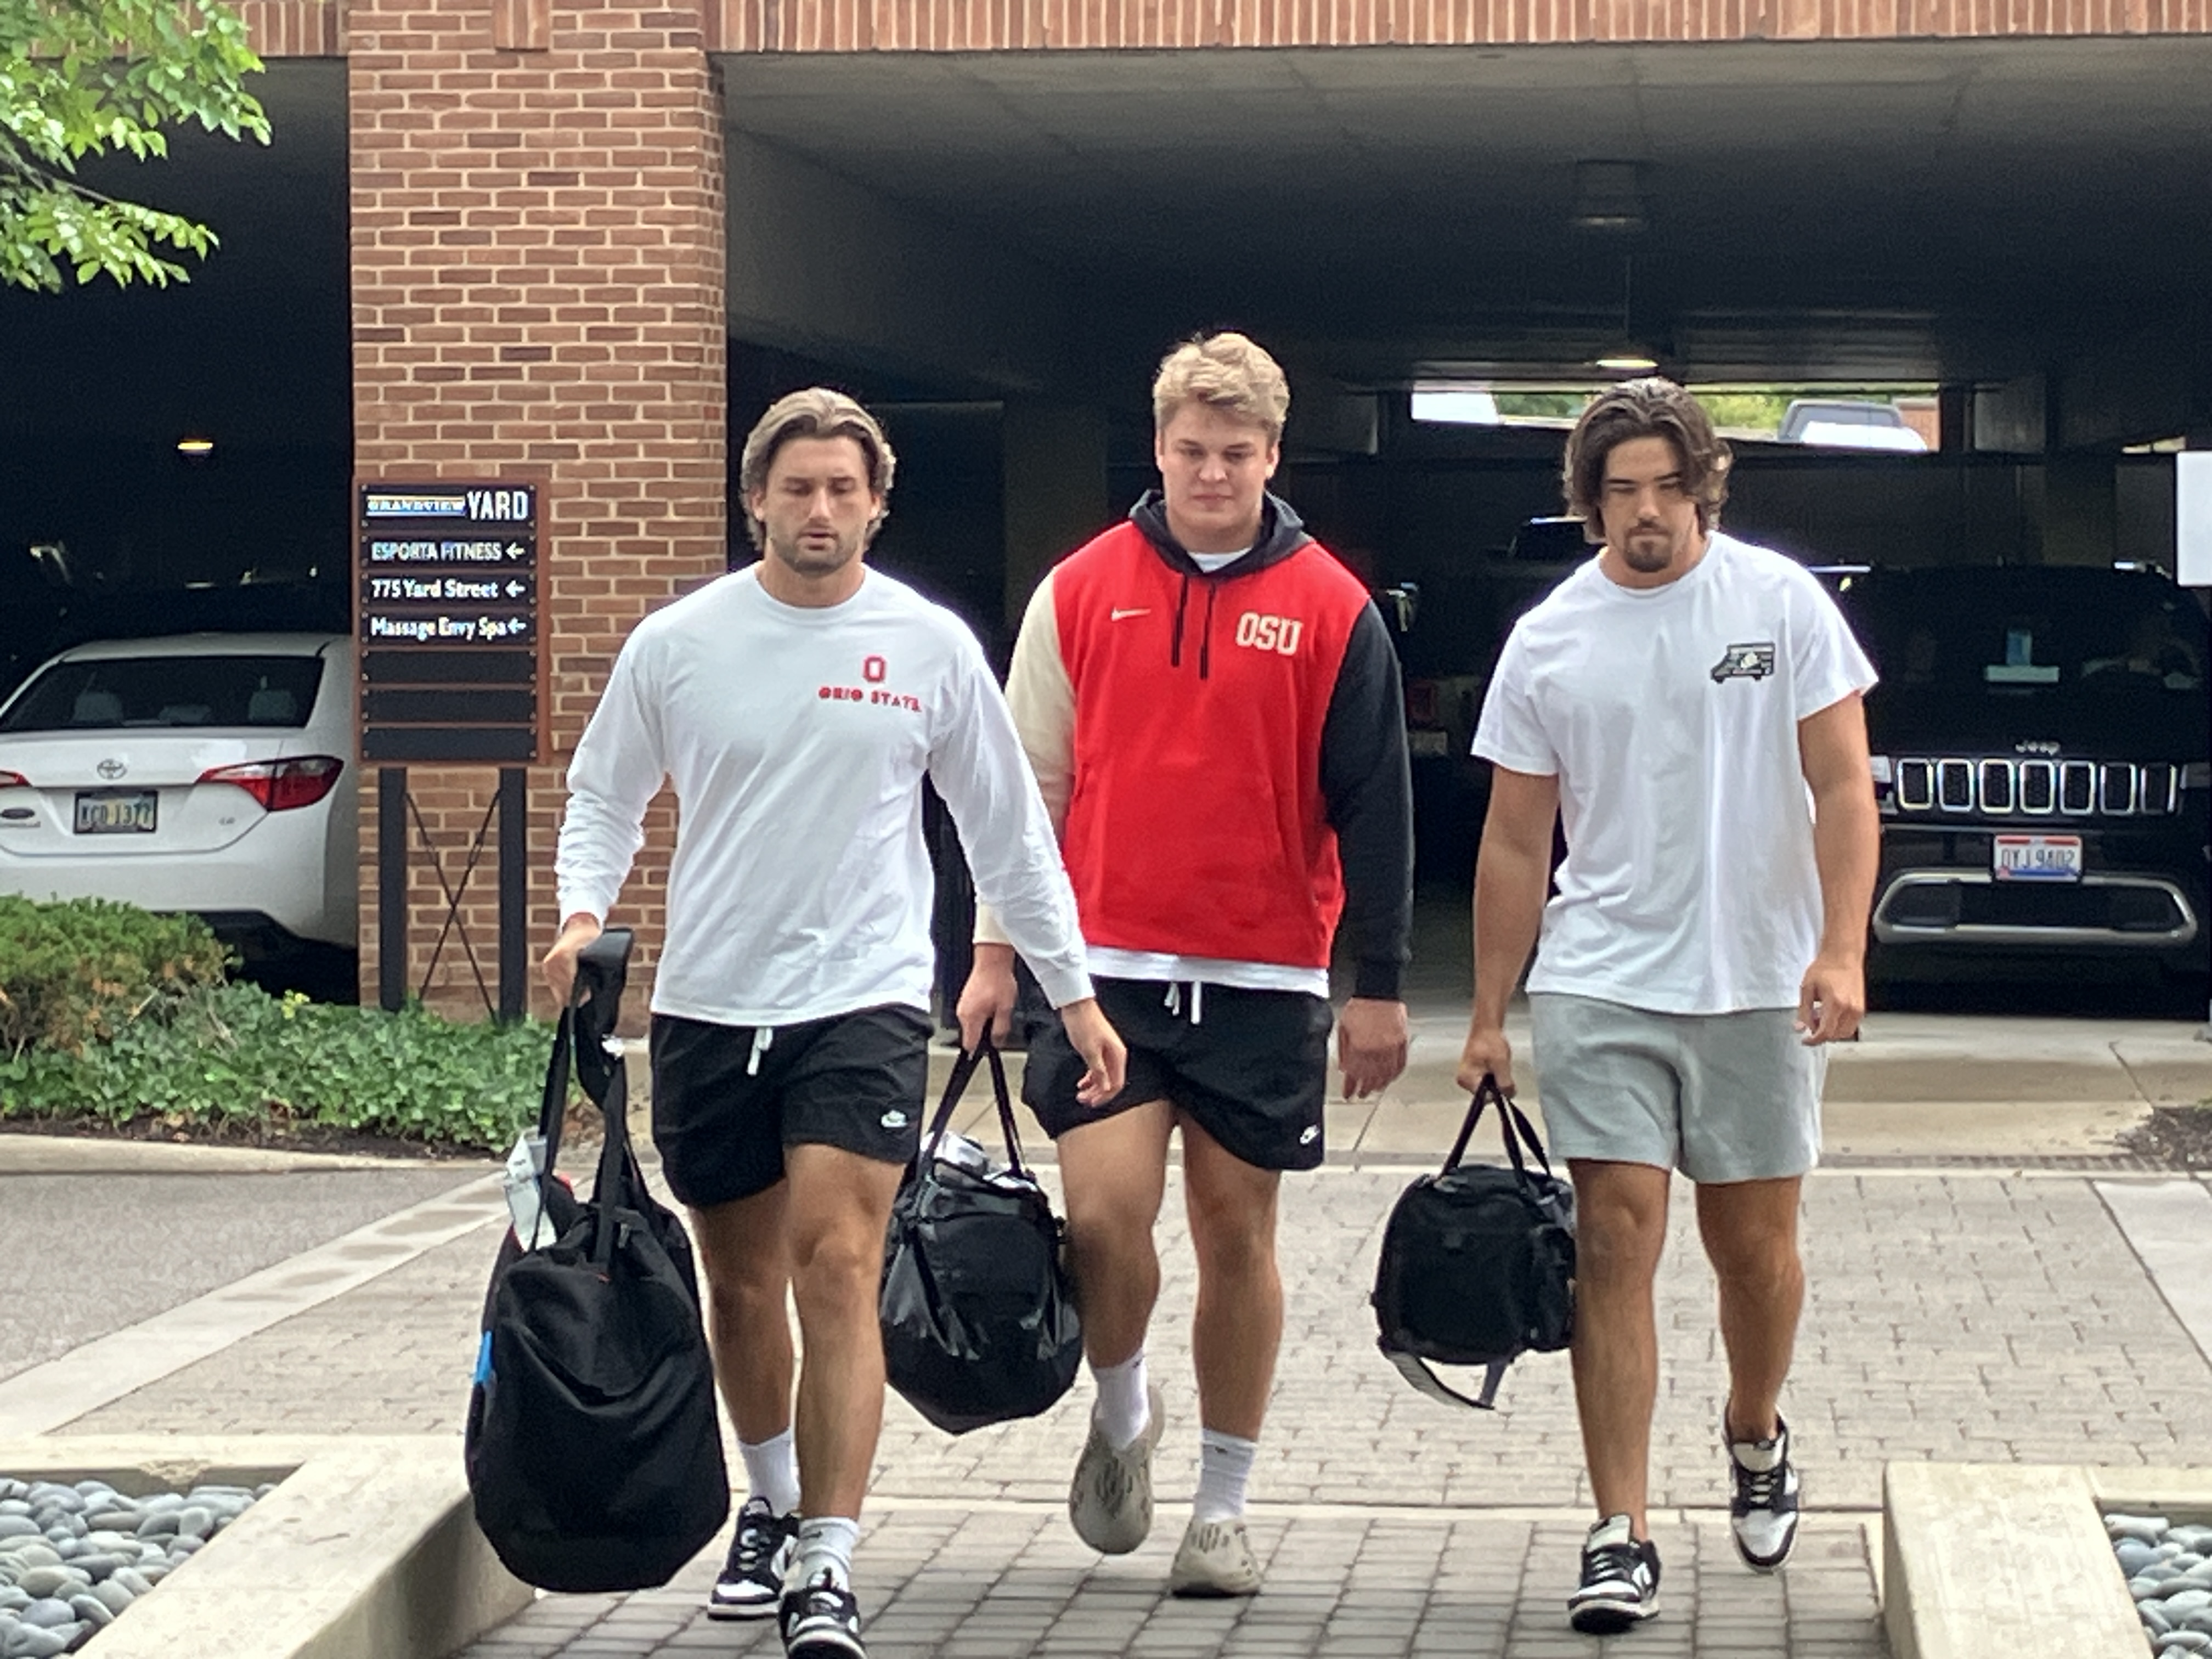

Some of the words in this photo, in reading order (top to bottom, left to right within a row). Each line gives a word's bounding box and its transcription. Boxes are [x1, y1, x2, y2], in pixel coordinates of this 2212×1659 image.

[467, 492, 527, 520] YARD
[371, 542, 438, 561] ESPORTA
[441, 542, 501, 561] FITNESS
[371, 579, 400, 597] 775
[403, 579, 441, 597] Yard
[445, 579, 498, 597] Street
[371, 617, 436, 641] Massage
[438, 617, 476, 640] Envy
[479, 617, 507, 640] Spa
[1236, 612, 1302, 656] OSU
[863, 656, 885, 683] O
[819, 687, 863, 701] OHIO
[871, 690, 921, 712] STATE
[2015, 740, 2061, 756] Jeep
